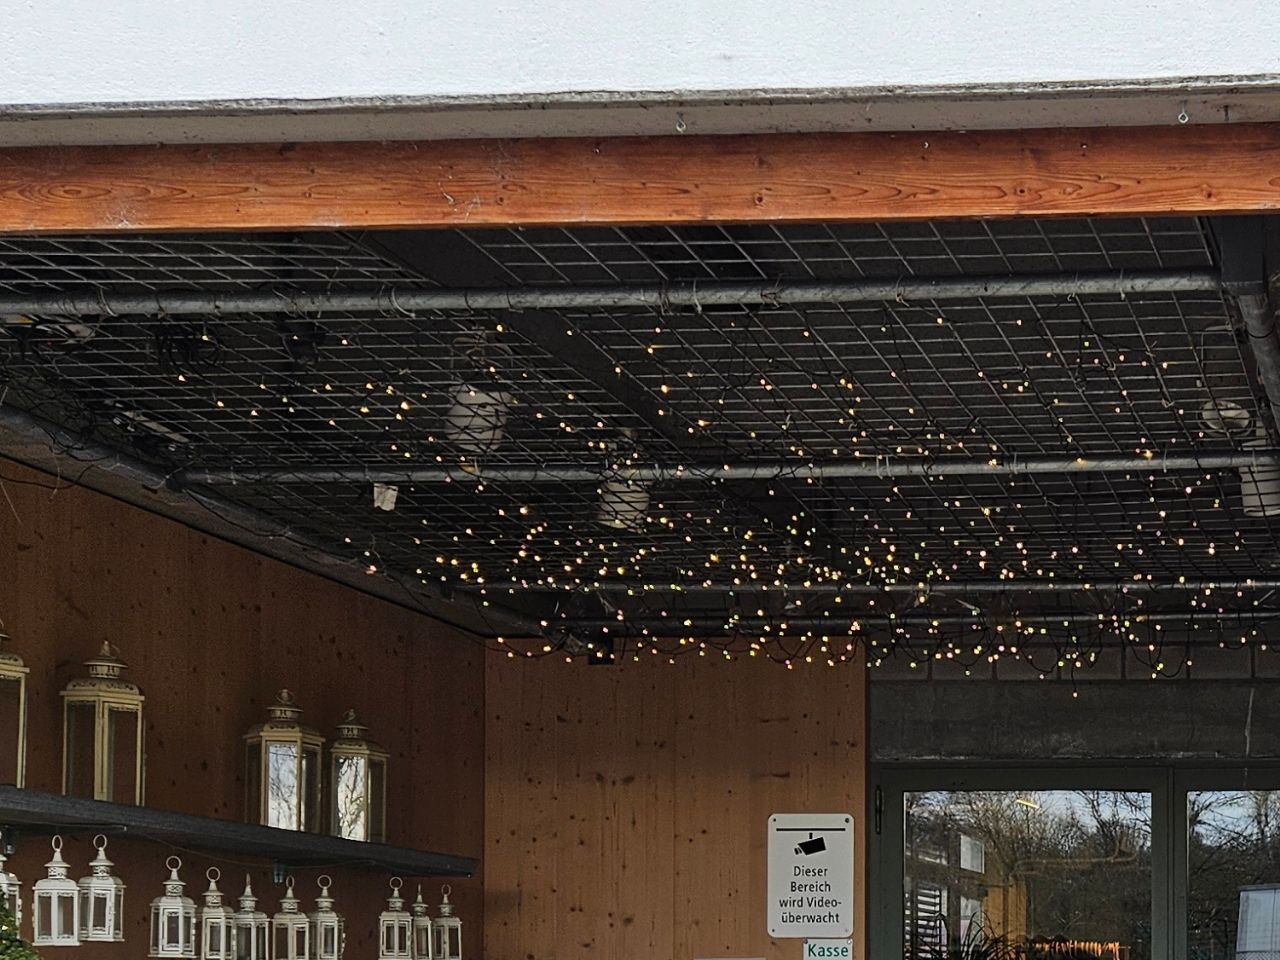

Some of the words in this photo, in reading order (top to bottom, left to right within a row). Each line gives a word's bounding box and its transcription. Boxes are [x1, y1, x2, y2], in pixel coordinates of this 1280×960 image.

[793, 865, 828, 877] Dieser
[790, 881, 831, 892] Bereich
[779, 896, 803, 908] wird
[806, 896, 842, 908] Video-
[781, 911, 840, 923] überwacht
[808, 943, 849, 957] Kasse
